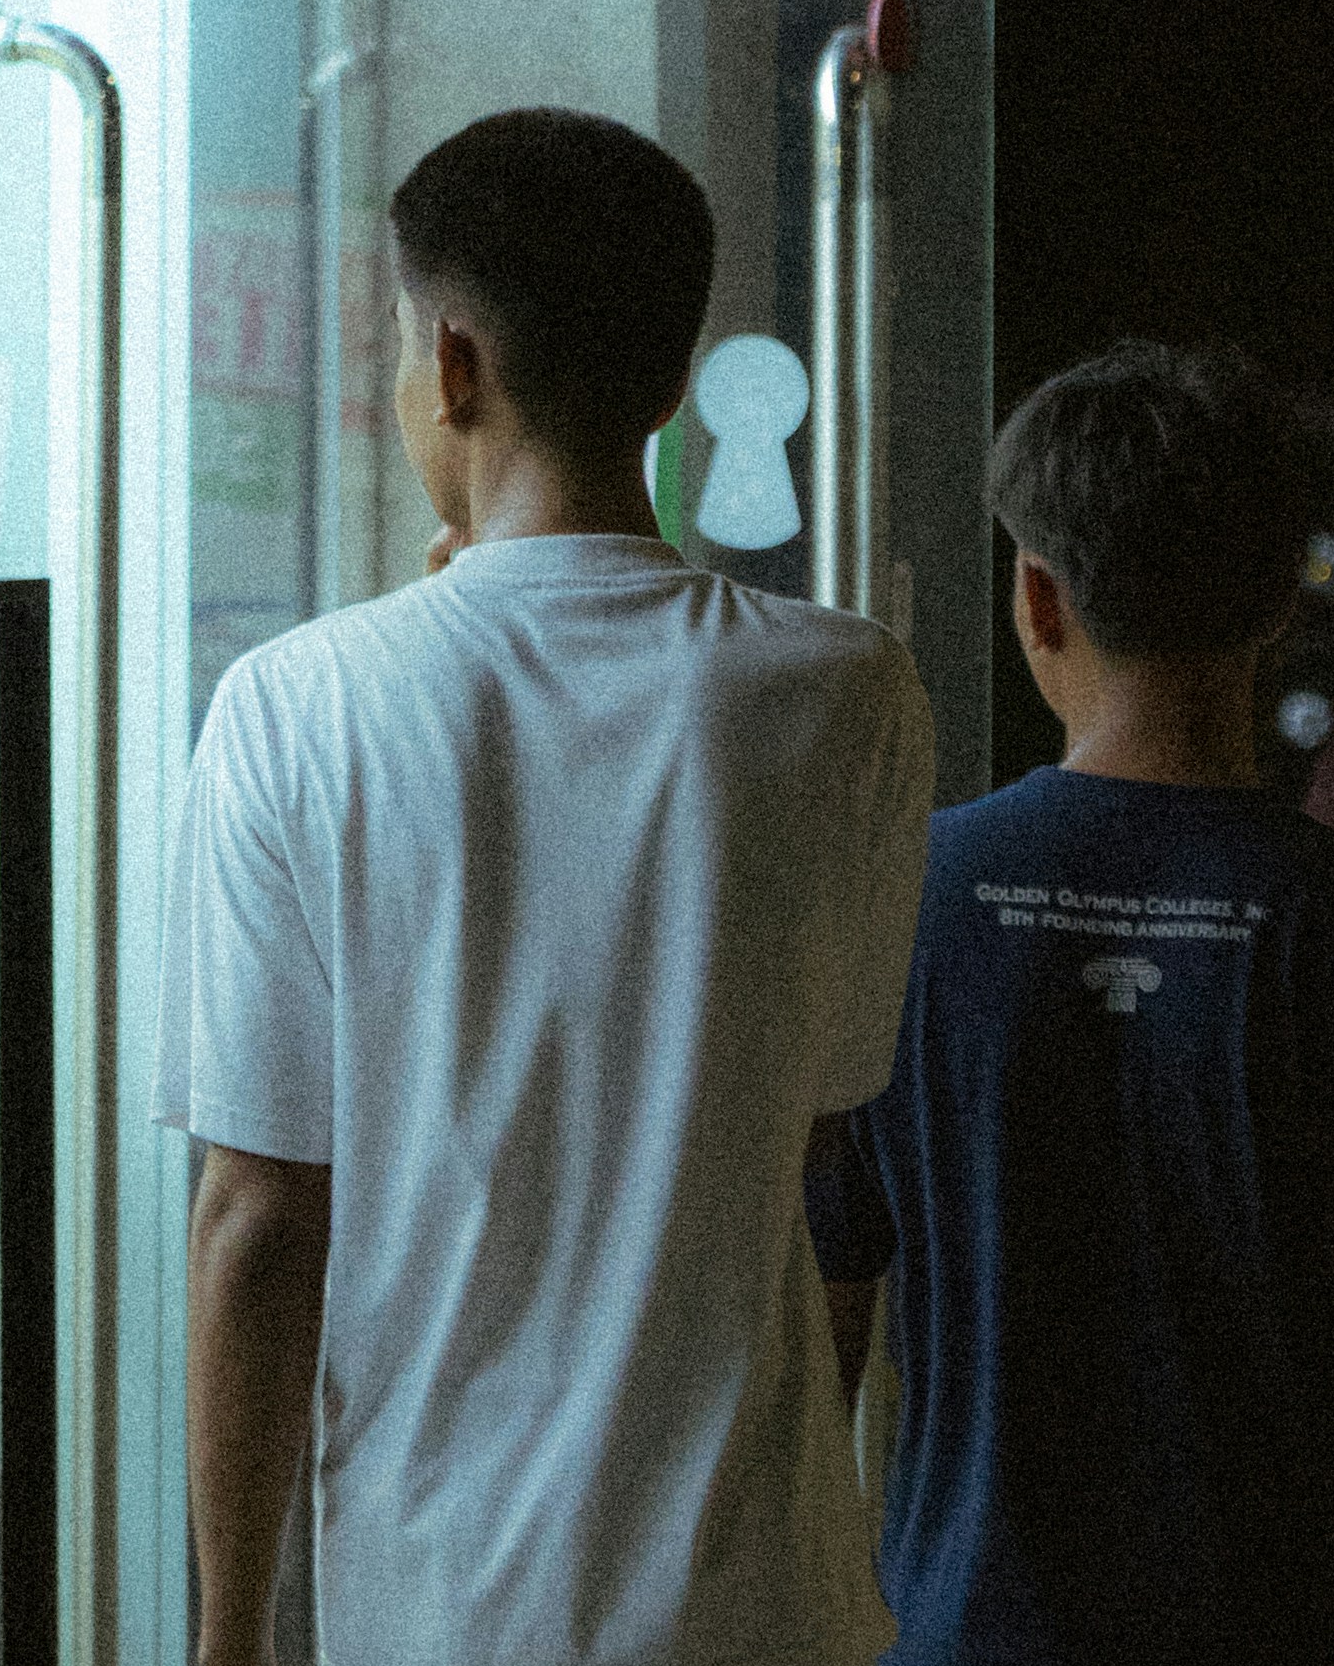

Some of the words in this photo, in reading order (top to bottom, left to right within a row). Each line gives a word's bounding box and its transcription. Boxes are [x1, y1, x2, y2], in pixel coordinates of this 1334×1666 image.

[976, 884, 1049, 904] GOLDEN
[1057, 889, 1142, 914] OLYMPUS
[1041, 912, 1134, 937] FOUNDING
[1135, 921, 1252, 942] ANNIVERSARY
